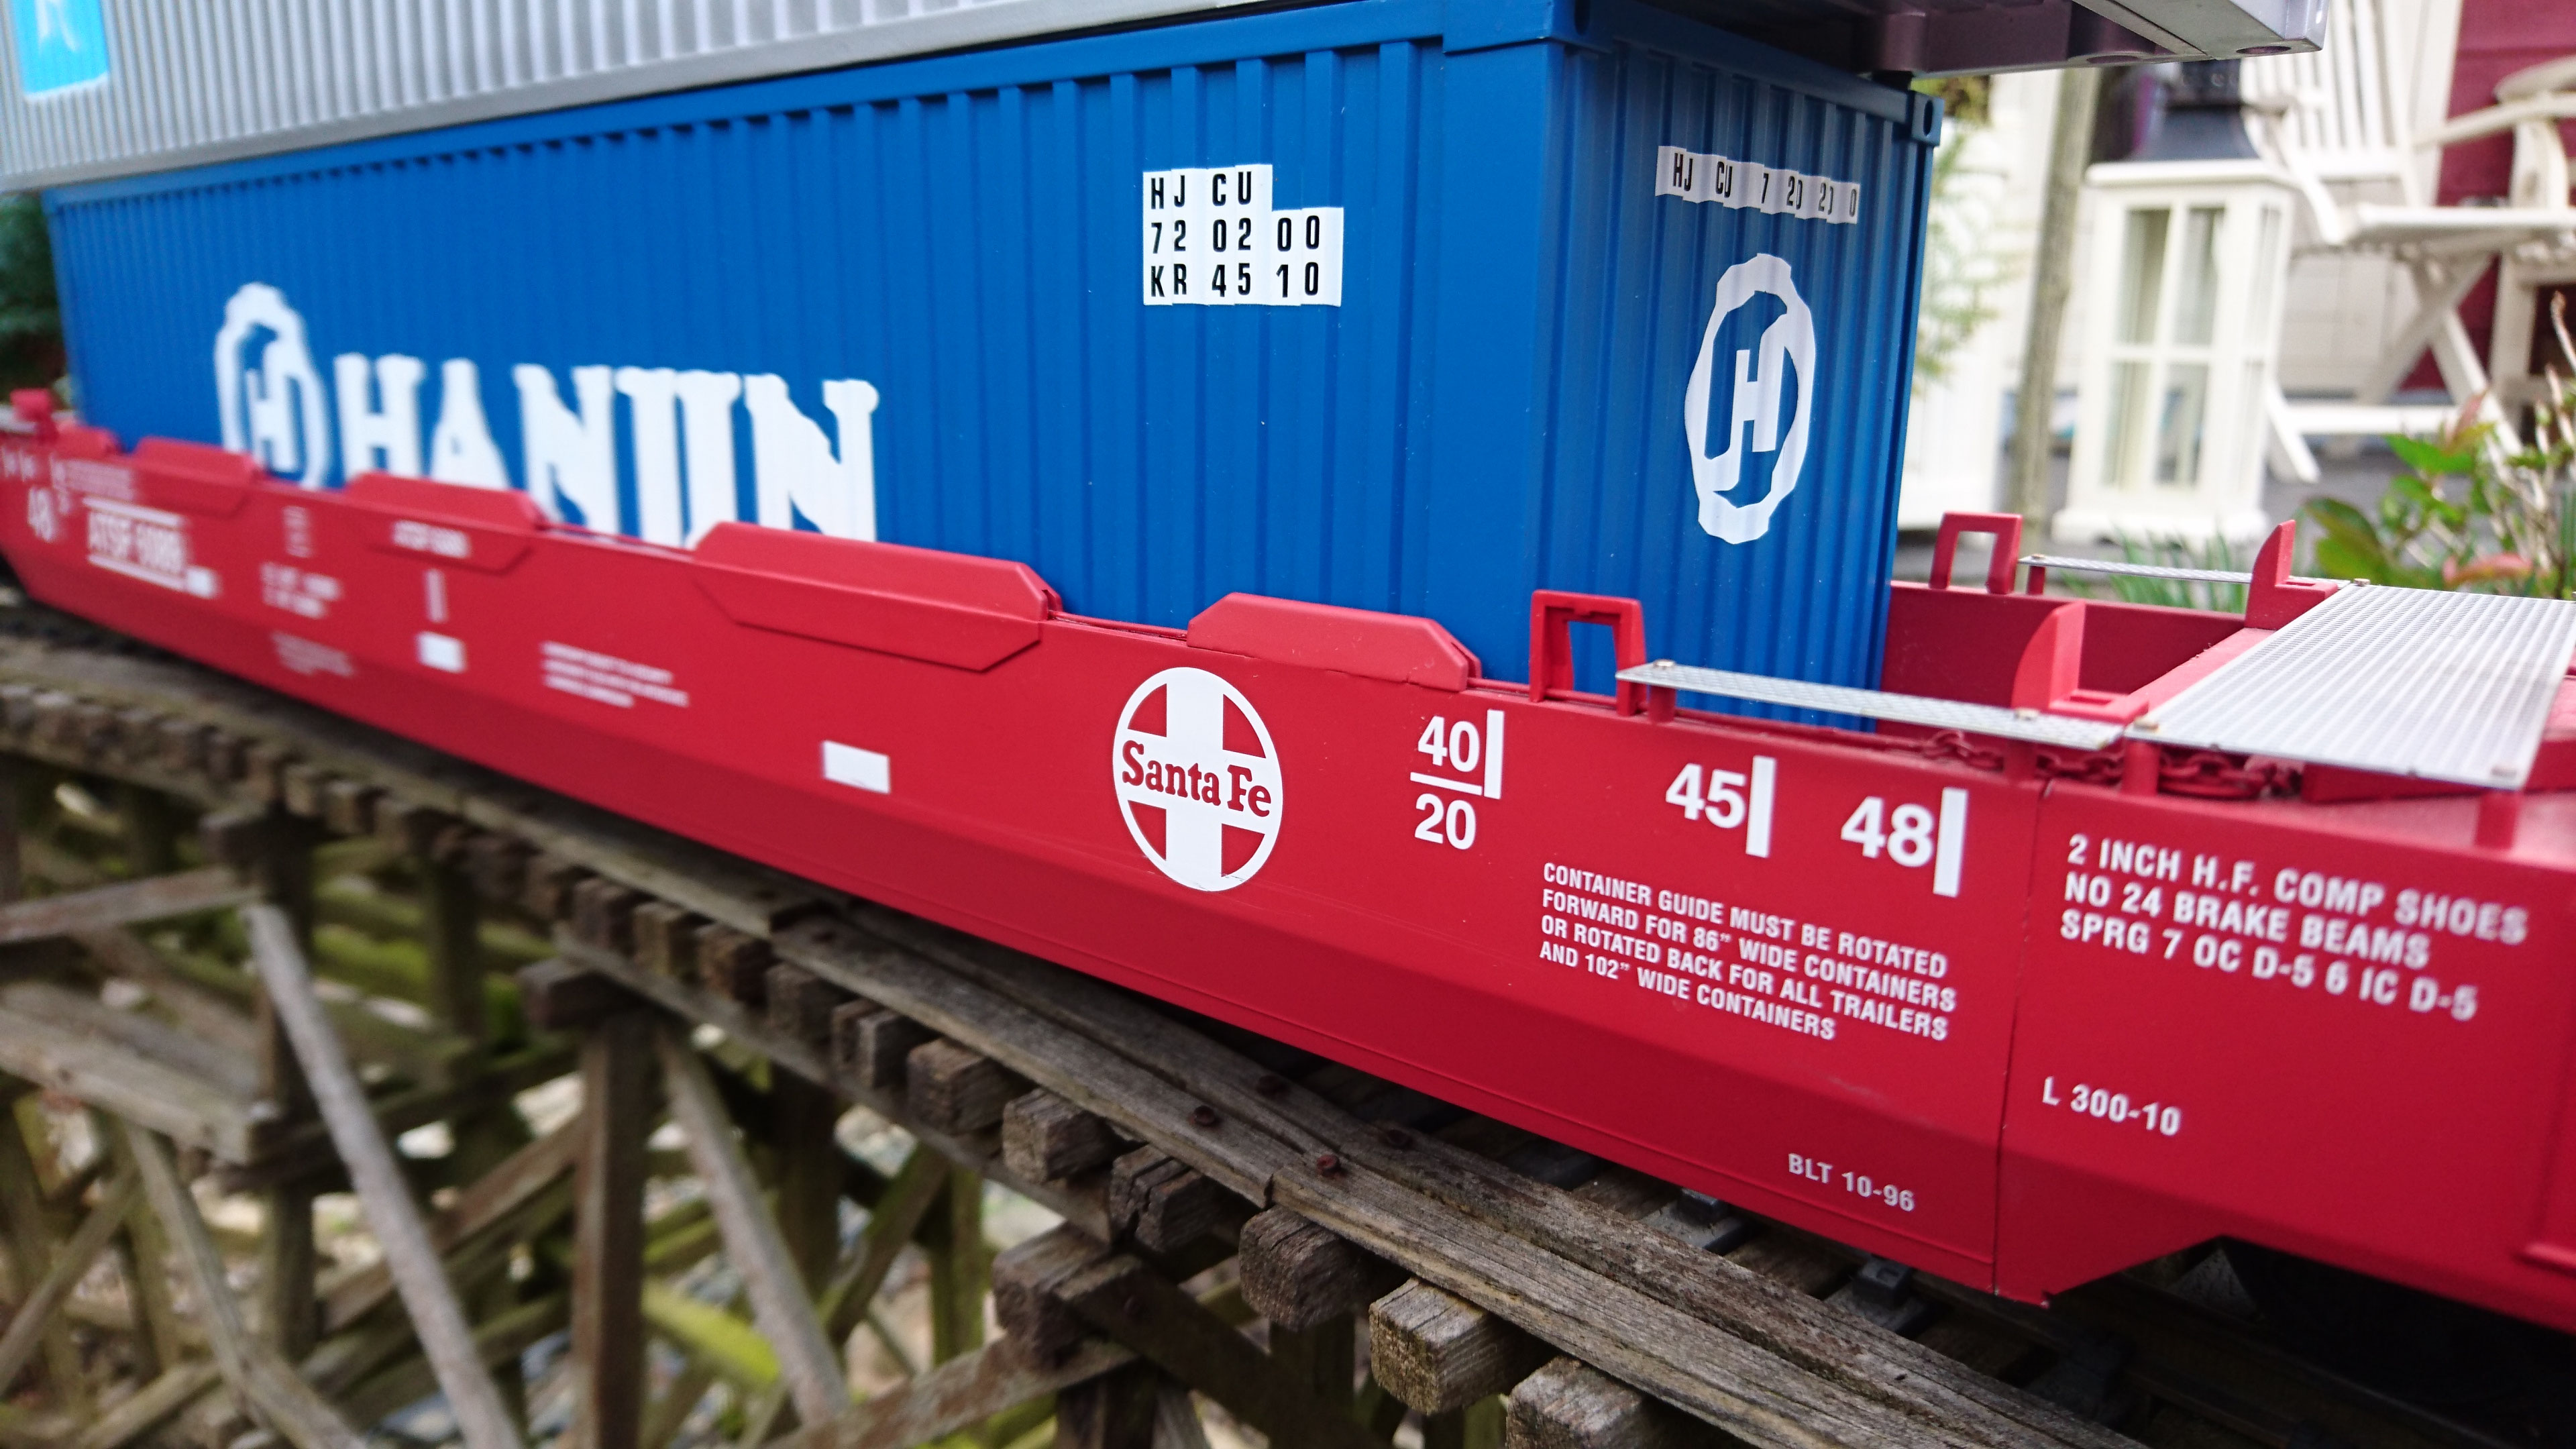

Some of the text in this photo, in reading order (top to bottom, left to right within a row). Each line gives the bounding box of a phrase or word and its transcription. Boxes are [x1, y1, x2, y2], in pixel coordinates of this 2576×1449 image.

[1151, 171, 1252, 209] HJ CU
[1151, 215, 1320, 254] 72 02 00
[1150, 262, 1319, 298] KR 45 10
[1417, 715, 1480, 772] 40
[1121, 740, 1273, 818] Santa Fe
[1666, 763, 1746, 828] 45
[1414, 794, 1476, 850] 20
[1841, 797, 1933, 867] 48
[1543, 863, 1947, 979] CONTAINER GUIDE MUST BE ROTATED
[2065, 871, 2430, 969] NO 24 BRAKE BEAMS
[2067, 833, 2528, 945] 2 INCH H.F. COMP SHOES
[1542, 915, 1948, 1041] OR ROTATED BACK FOR ALL TRAILERS
[1543, 889, 1638, 930] FORWARD
[1646, 914, 1686, 943] FOR
[1739, 938, 1798, 972] WIDE
[1805, 955, 1956, 1012] CONTAINERS
[2061, 909, 2477, 1020] SPRG 7 OC D-5 6 IC D-5
[1540, 941, 1578, 967] AND
[1638, 967, 1690, 1000] WIDE
[1697, 984, 1835, 1040] CONTAINERS
[2042, 1076, 2181, 1136] L 300-10
[1788, 1152, 1915, 1212] BLT 10-96
